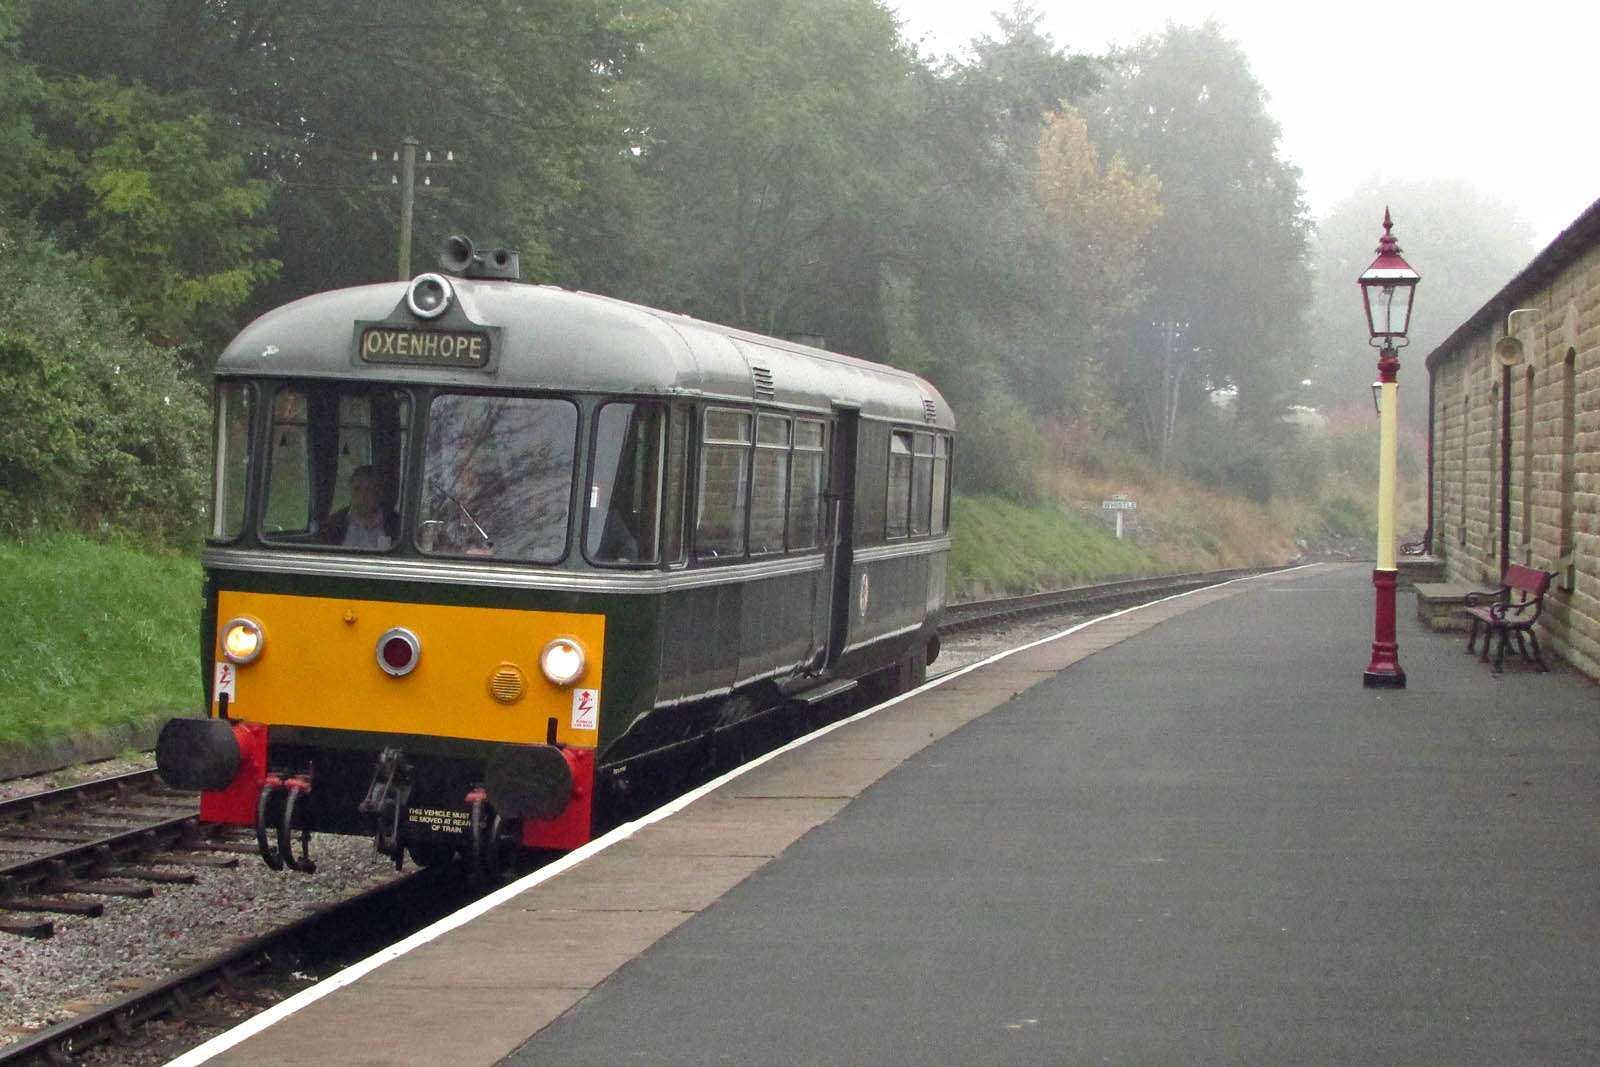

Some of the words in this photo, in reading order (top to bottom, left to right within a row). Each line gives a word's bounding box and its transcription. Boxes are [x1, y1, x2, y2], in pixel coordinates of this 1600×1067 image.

[367, 331, 482, 359] OXENHOPE
[424, 809, 451, 817] VEHICLE
[419, 816, 443, 824] MOVED
[453, 819, 471, 827] REAR
